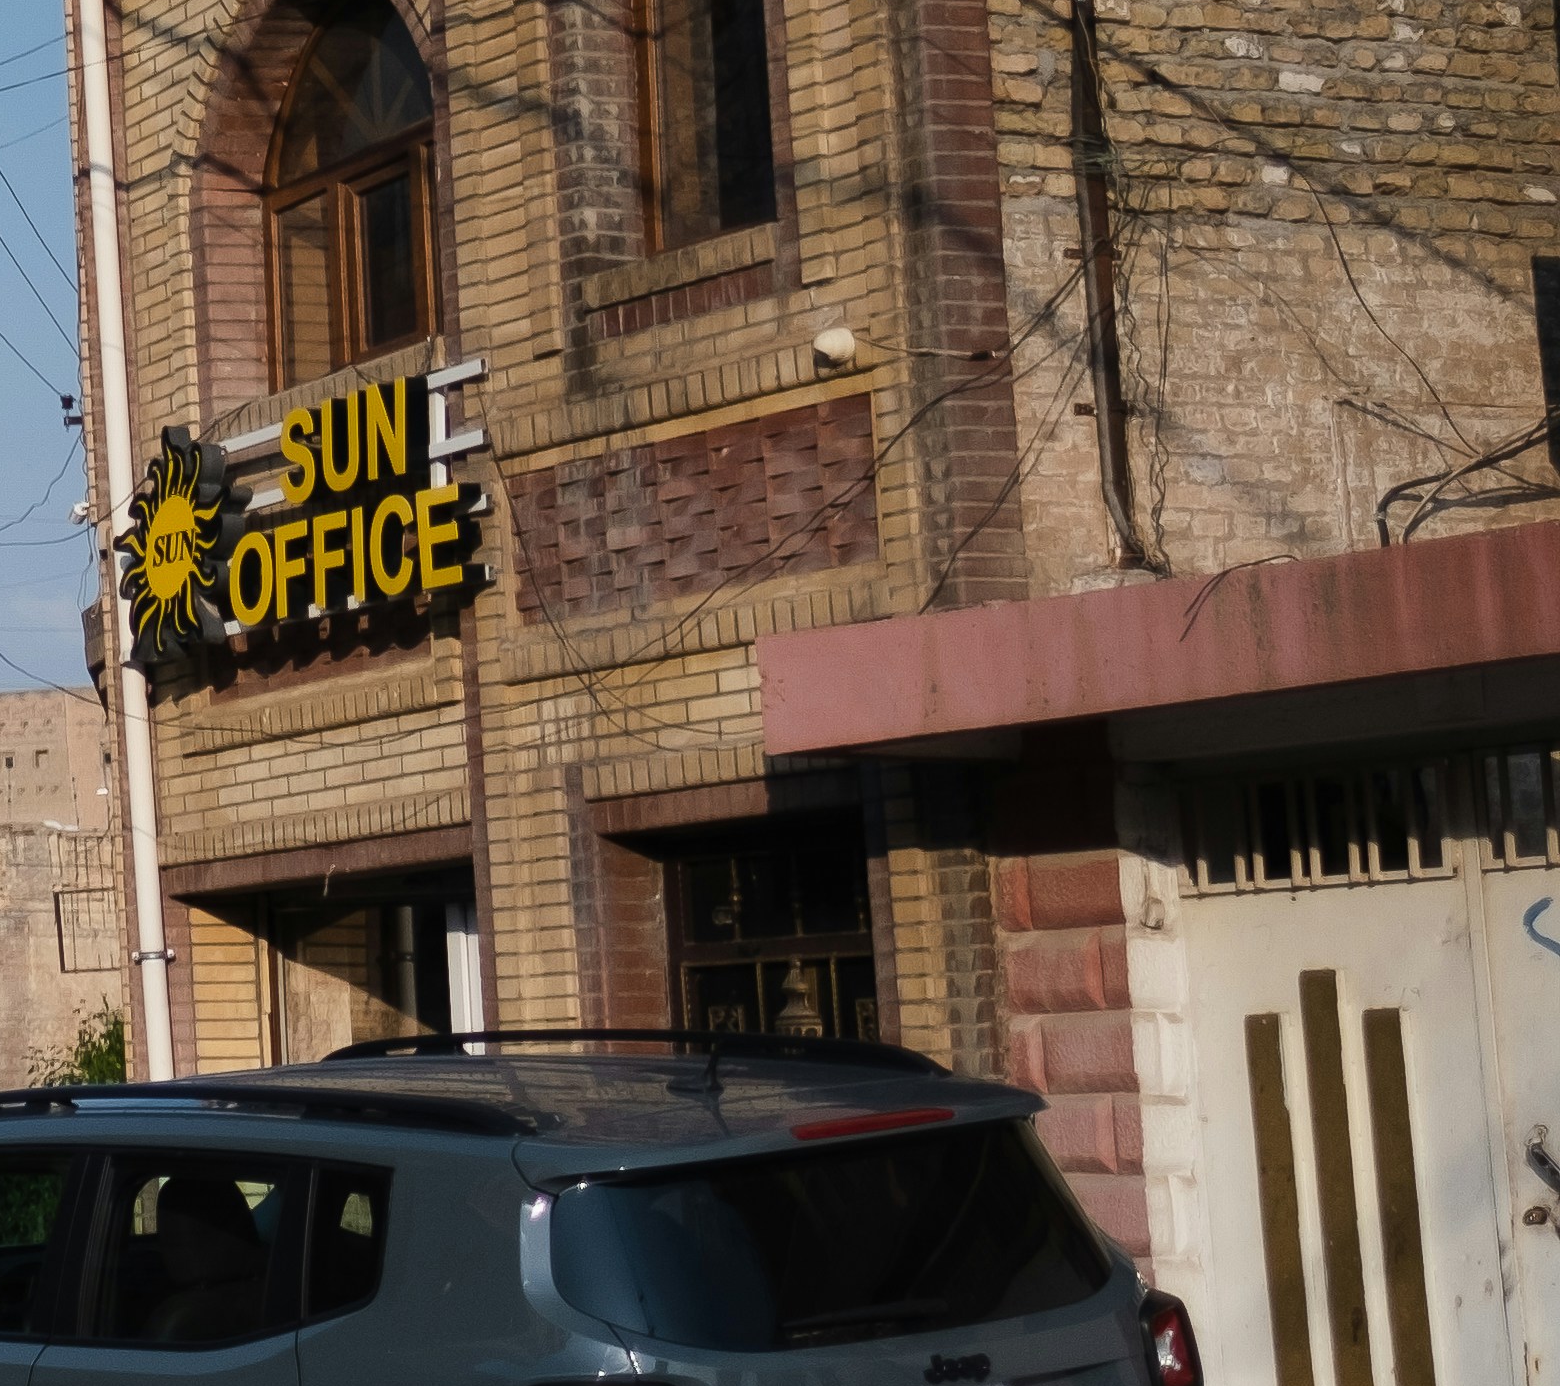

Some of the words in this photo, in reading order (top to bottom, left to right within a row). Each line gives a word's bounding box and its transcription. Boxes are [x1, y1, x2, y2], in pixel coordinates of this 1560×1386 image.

[280, 376, 406, 504] SUN
[153, 527, 196, 569] SUN
[230, 483, 463, 626] OFFICE
